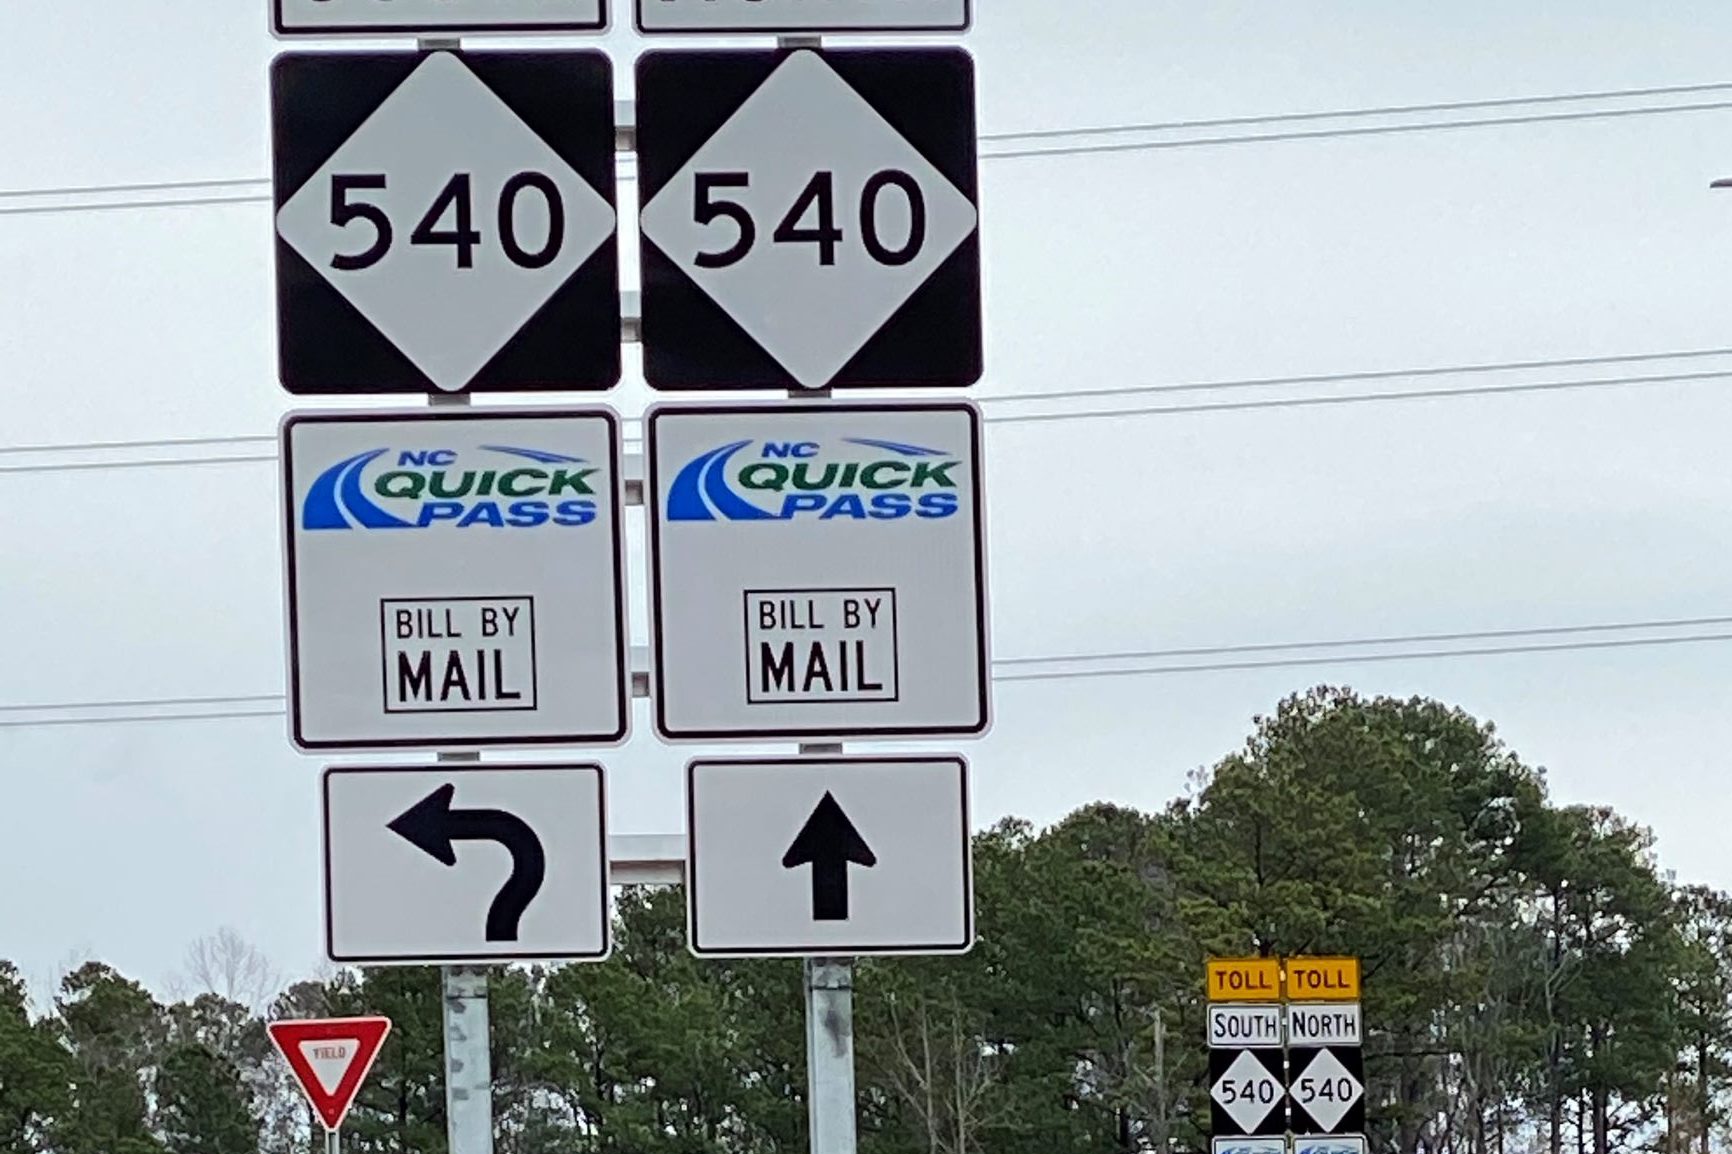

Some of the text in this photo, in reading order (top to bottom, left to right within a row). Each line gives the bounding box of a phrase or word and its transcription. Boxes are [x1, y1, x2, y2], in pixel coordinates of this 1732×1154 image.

[329, 171, 565, 271] 540
[693, 168, 926, 267] 540
[397, 449, 457, 467] NC
[760, 441, 821, 459] NC
[373, 467, 599, 499] QUICK
[737, 460, 963, 492] QUICK
[415, 500, 598, 528] PASS
[780, 493, 960, 520] PASS
[396, 607, 520, 639] BILL BY
[759, 599, 882, 630] BILL BY
[400, 650, 521, 702] MAIL
[760, 640, 883, 693] MAIL
[1215, 970, 1272, 990] TOLL
[1293, 969, 1350, 989] TOLL
[1214, 1013, 1277, 1038] SOUTH
[1292, 1012, 1356, 1037] NORTH
[313, 1046, 346, 1059] YIELD
[1222, 1079, 1275, 1104] 540
[1301, 1077, 1353, 1103] 540
